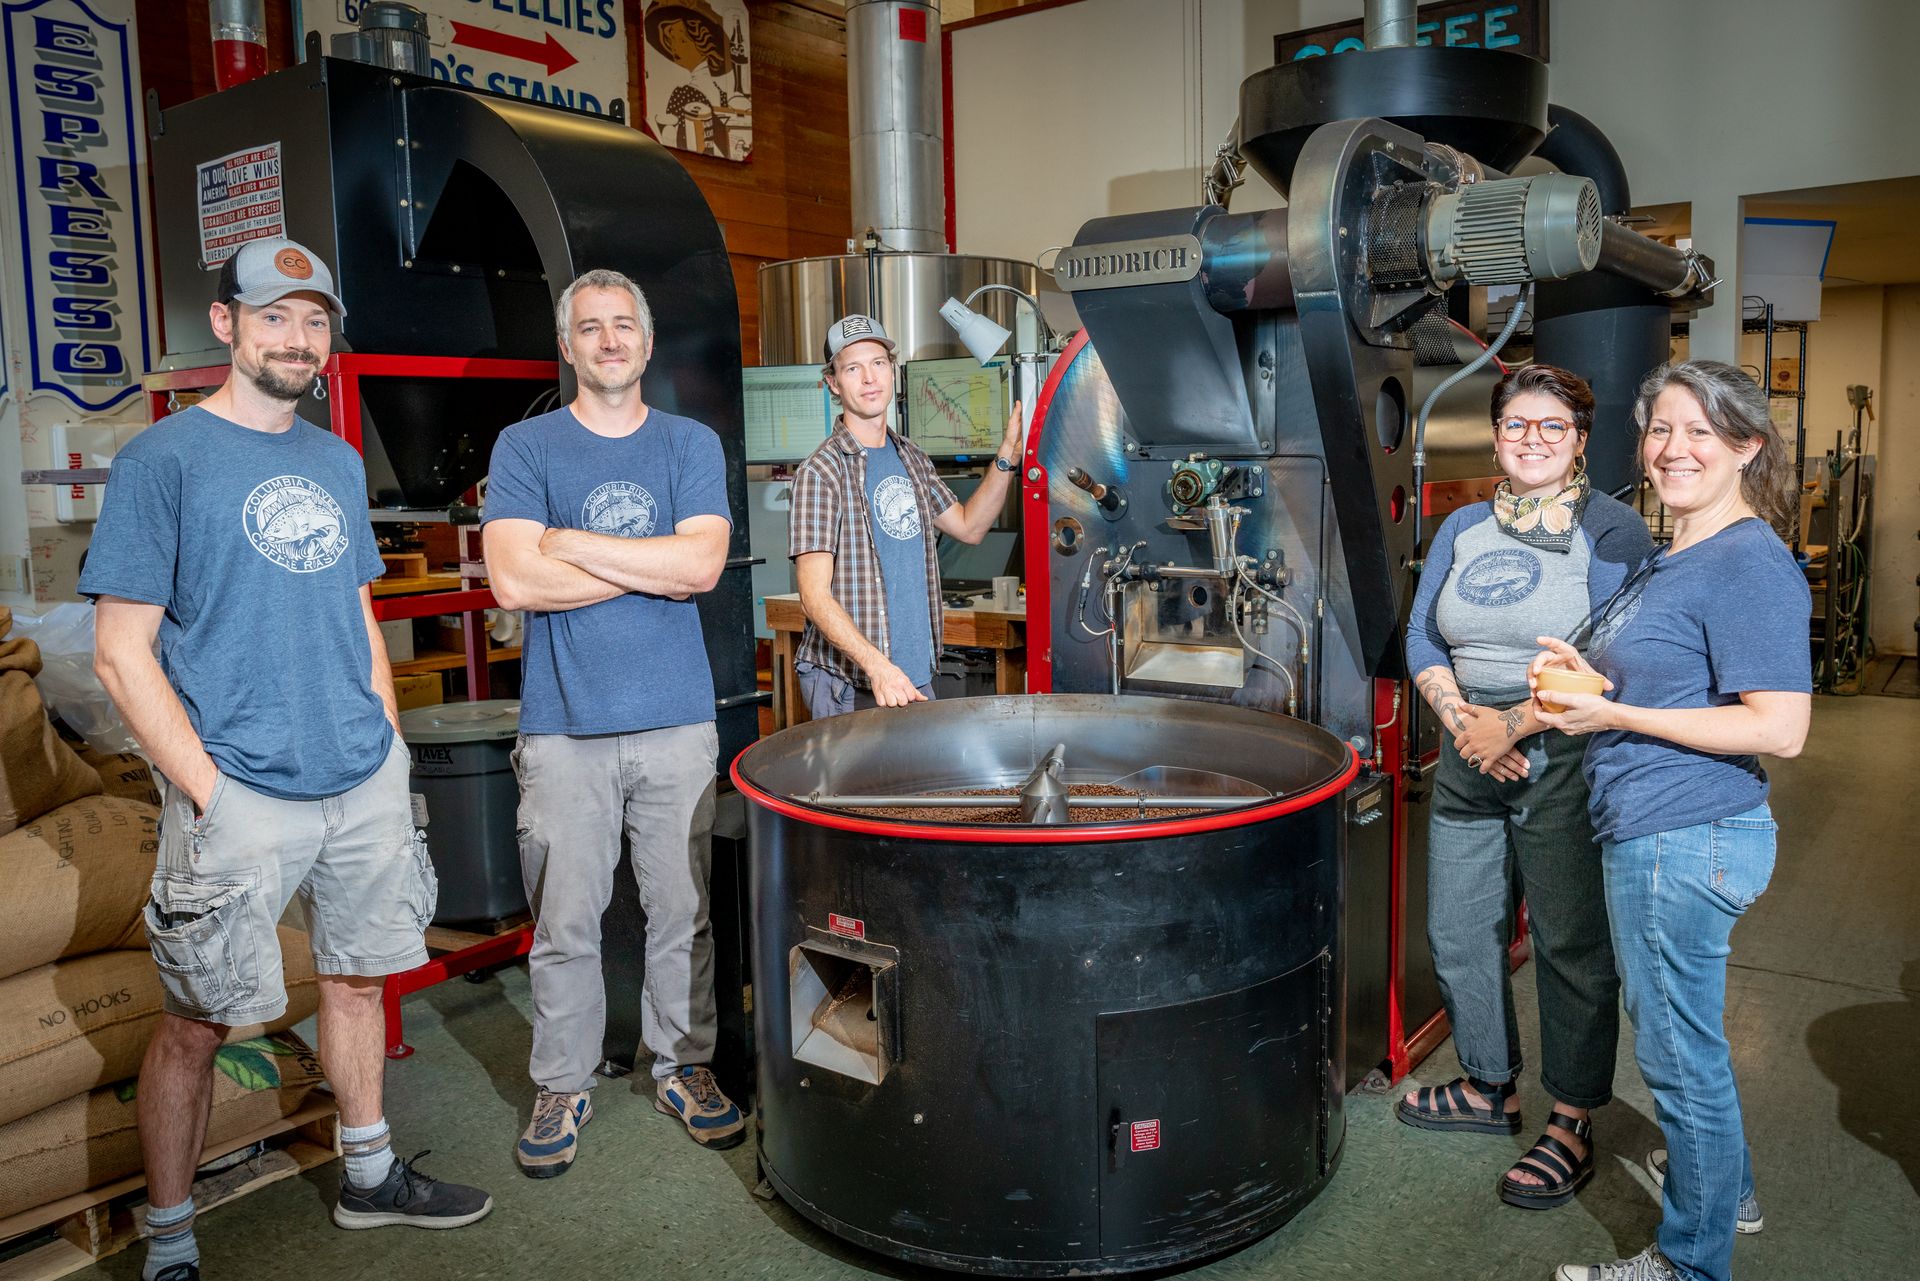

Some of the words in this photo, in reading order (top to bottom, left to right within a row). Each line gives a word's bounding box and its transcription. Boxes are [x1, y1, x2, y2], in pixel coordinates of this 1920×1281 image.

[202, 171, 210, 188] IN
[212, 167, 226, 185] OUR
[227, 166, 248, 186] LOVE
[253, 159, 279, 179] WINS
[33, 15, 124, 376] ESPRESSO
[203, 184, 228, 203] AMERICA
[228, 186, 242, 197] BLACK
[243, 182, 256, 193] LIVES
[259, 177, 279, 189] MATTER
[259, 189, 281, 202] WELCOME
[204, 211, 235, 228] DISABILITIES
[248, 202, 280, 217] RESPECTED
[1067, 248, 1187, 279] DIEDRICH
[69, 453, 82, 469] Aid
[246, 477, 304, 515] COLUMBIA
[308, 483, 343, 516] RIVER
[585, 483, 626, 511] COLUMBIA
[628, 485, 653, 510] RIVER
[1484, 583, 1535, 606] ROASTER
[417, 744, 454, 765] LAVEX
[39, 1010, 66, 1030] NO
[73, 988, 131, 1018] HOOKS
